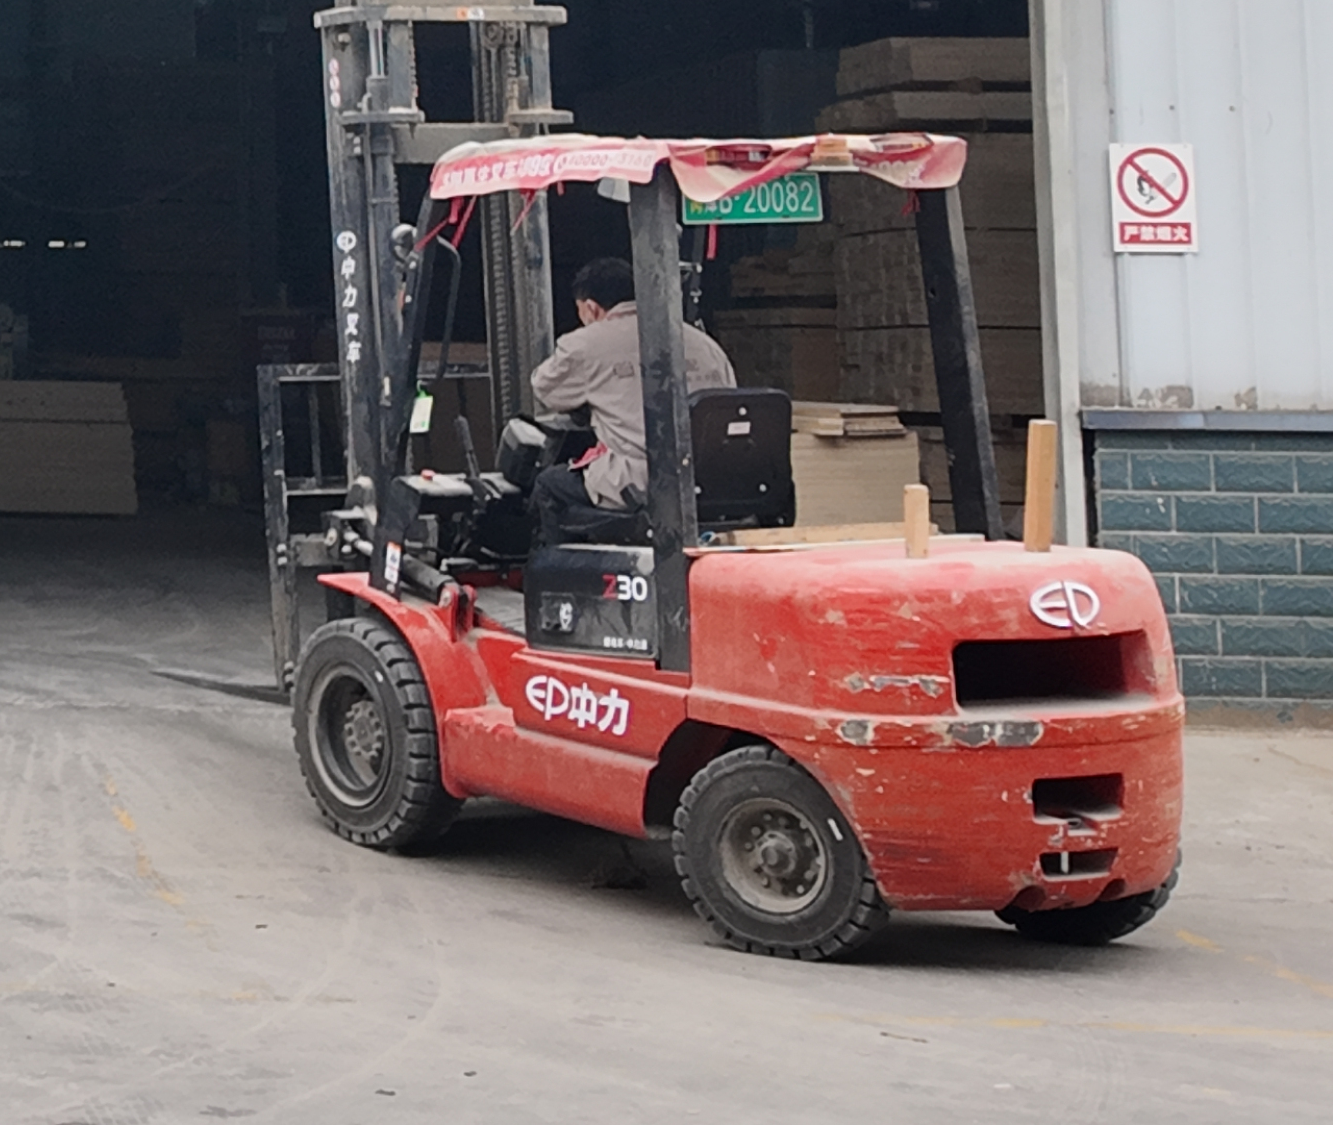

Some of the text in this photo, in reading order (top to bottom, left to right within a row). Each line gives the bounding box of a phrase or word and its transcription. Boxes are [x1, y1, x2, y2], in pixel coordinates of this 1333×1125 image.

[1123, 225, 1189, 242] 严禁烟火
[602, 573, 648, 601] Z30
